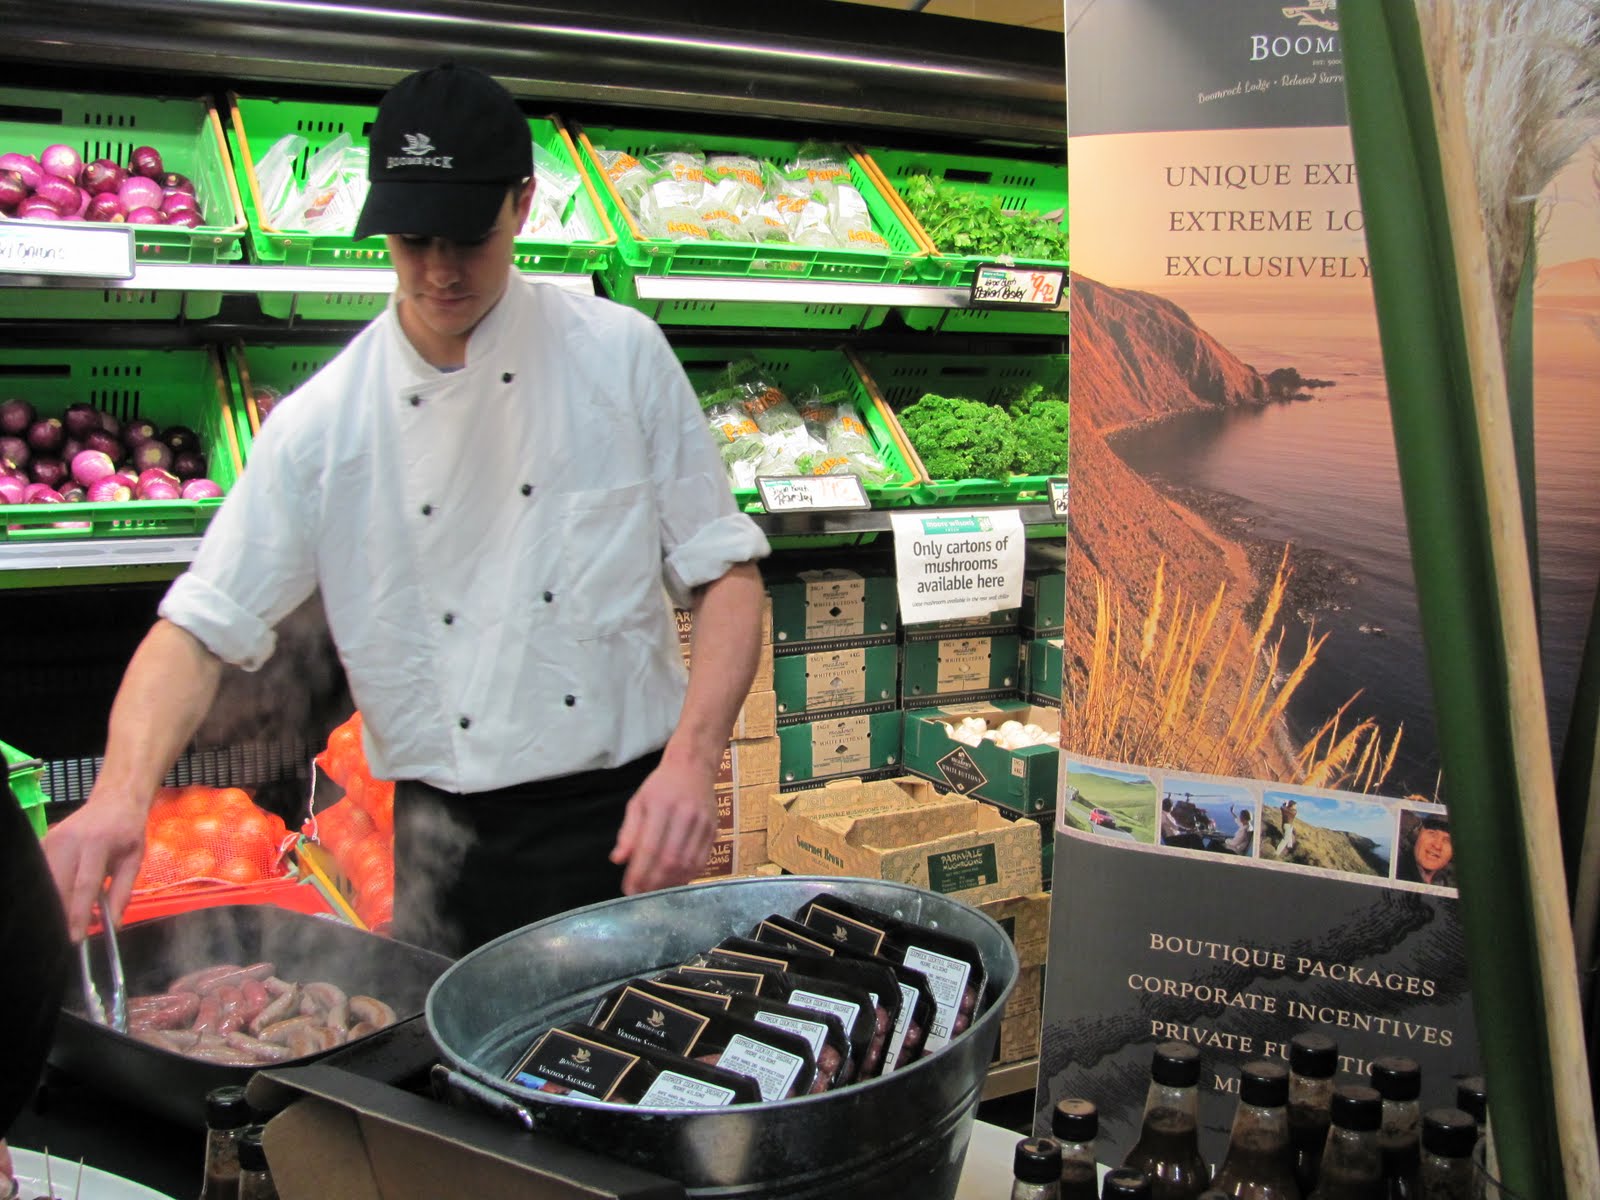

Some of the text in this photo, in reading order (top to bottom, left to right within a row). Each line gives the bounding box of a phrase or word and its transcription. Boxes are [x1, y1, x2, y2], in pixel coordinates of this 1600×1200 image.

[1250, 35, 1335, 60] BOOM
[1244, 78, 1271, 93] Lodge
[1281, 73, 1316, 86] Relaxed
[1165, 164, 1291, 190] UNIQUE
[1169, 210, 1312, 232] EXTREME
[1165, 256, 1372, 278] EXCLUSIVELY
[913, 536, 1009, 559] Only cartons of
[924, 557, 998, 574] mushrooms
[917, 574, 1005, 593] available here
[941, 849, 982, 864] PARKVALE
[943, 858, 983, 871] MUSHROOMS
[1150, 933, 1436, 997] BOUTIQUE PACKAGES
[1128, 974, 1453, 1047] CORPORATE INCENTIVES
[1151, 1020, 1253, 1053] PRIVATE
[538, 1064, 596, 1090] VENISON SAUSAGES
